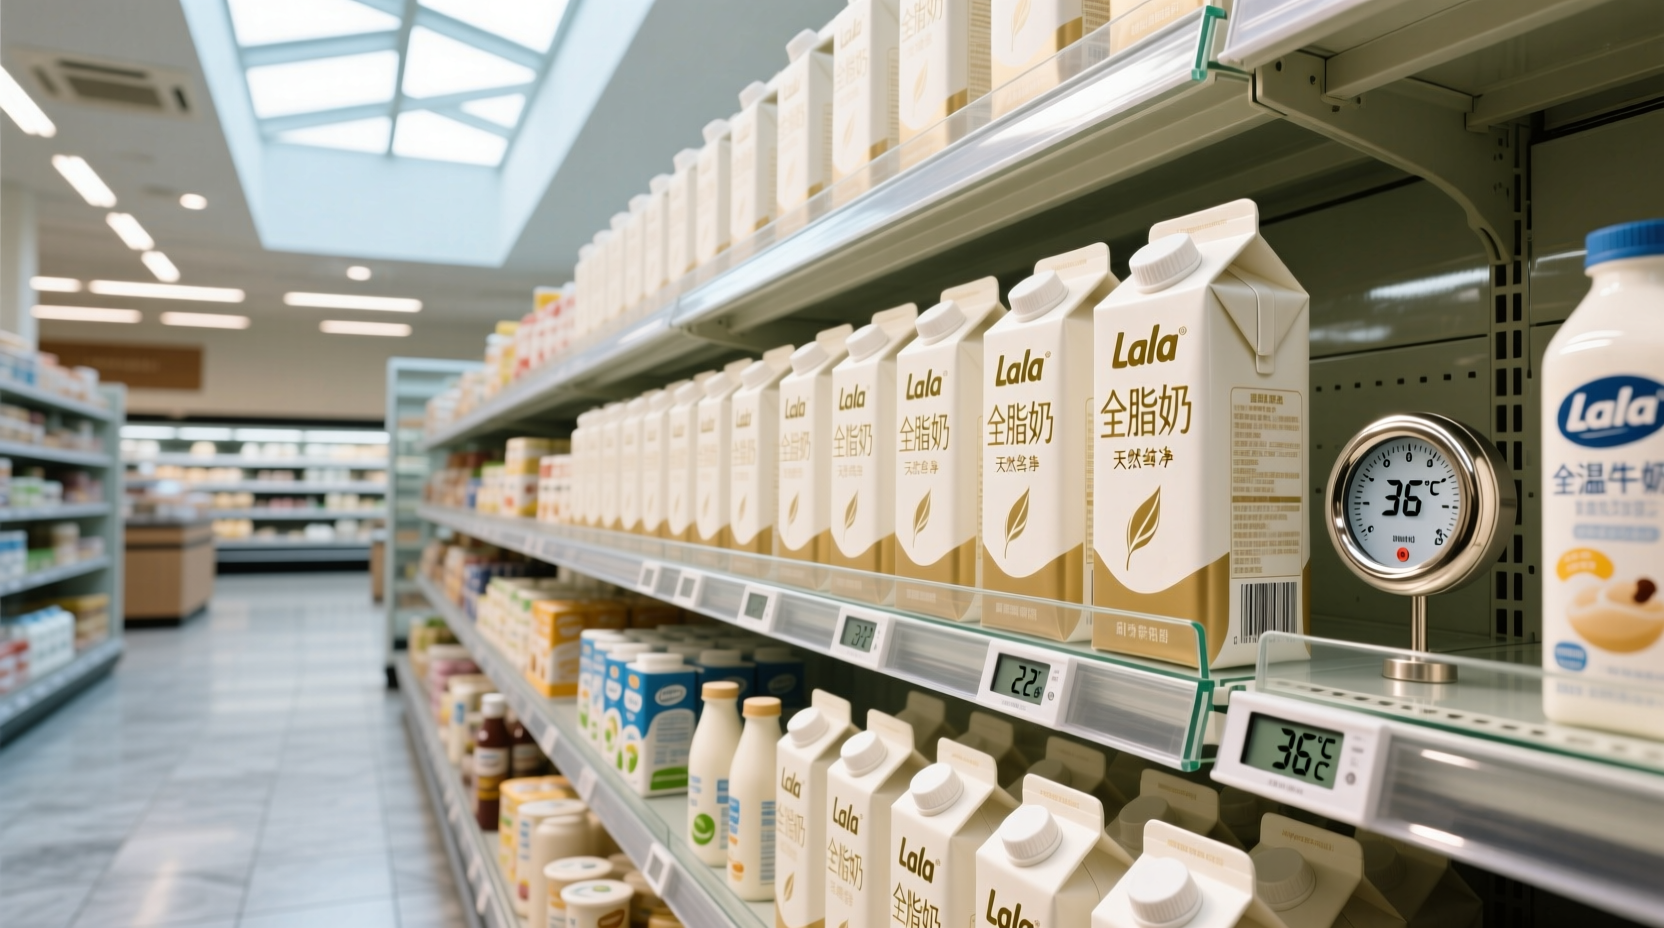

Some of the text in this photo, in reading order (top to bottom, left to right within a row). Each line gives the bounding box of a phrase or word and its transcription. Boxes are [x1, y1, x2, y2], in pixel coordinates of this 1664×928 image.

[1112, 324, 1179, 369] Lala
[906, 369, 942, 400] Lala
[995, 349, 1044, 387] Lala
[785, 396, 806, 419] Lala
[839, 384, 866, 411] Lala
[1101, 384, 1192, 438] 全脂奶
[1565, 386, 1659, 432] Lala
[833, 422, 873, 458] 全脂奶
[899, 413, 949, 452] 全脂奶
[987, 401, 1053, 446] 全脂奶
[781, 767, 801, 799] Lala
[833, 797, 858, 836] Lala
[828, 838, 863, 891] 全脂奶
[899, 837, 934, 884] Lala
